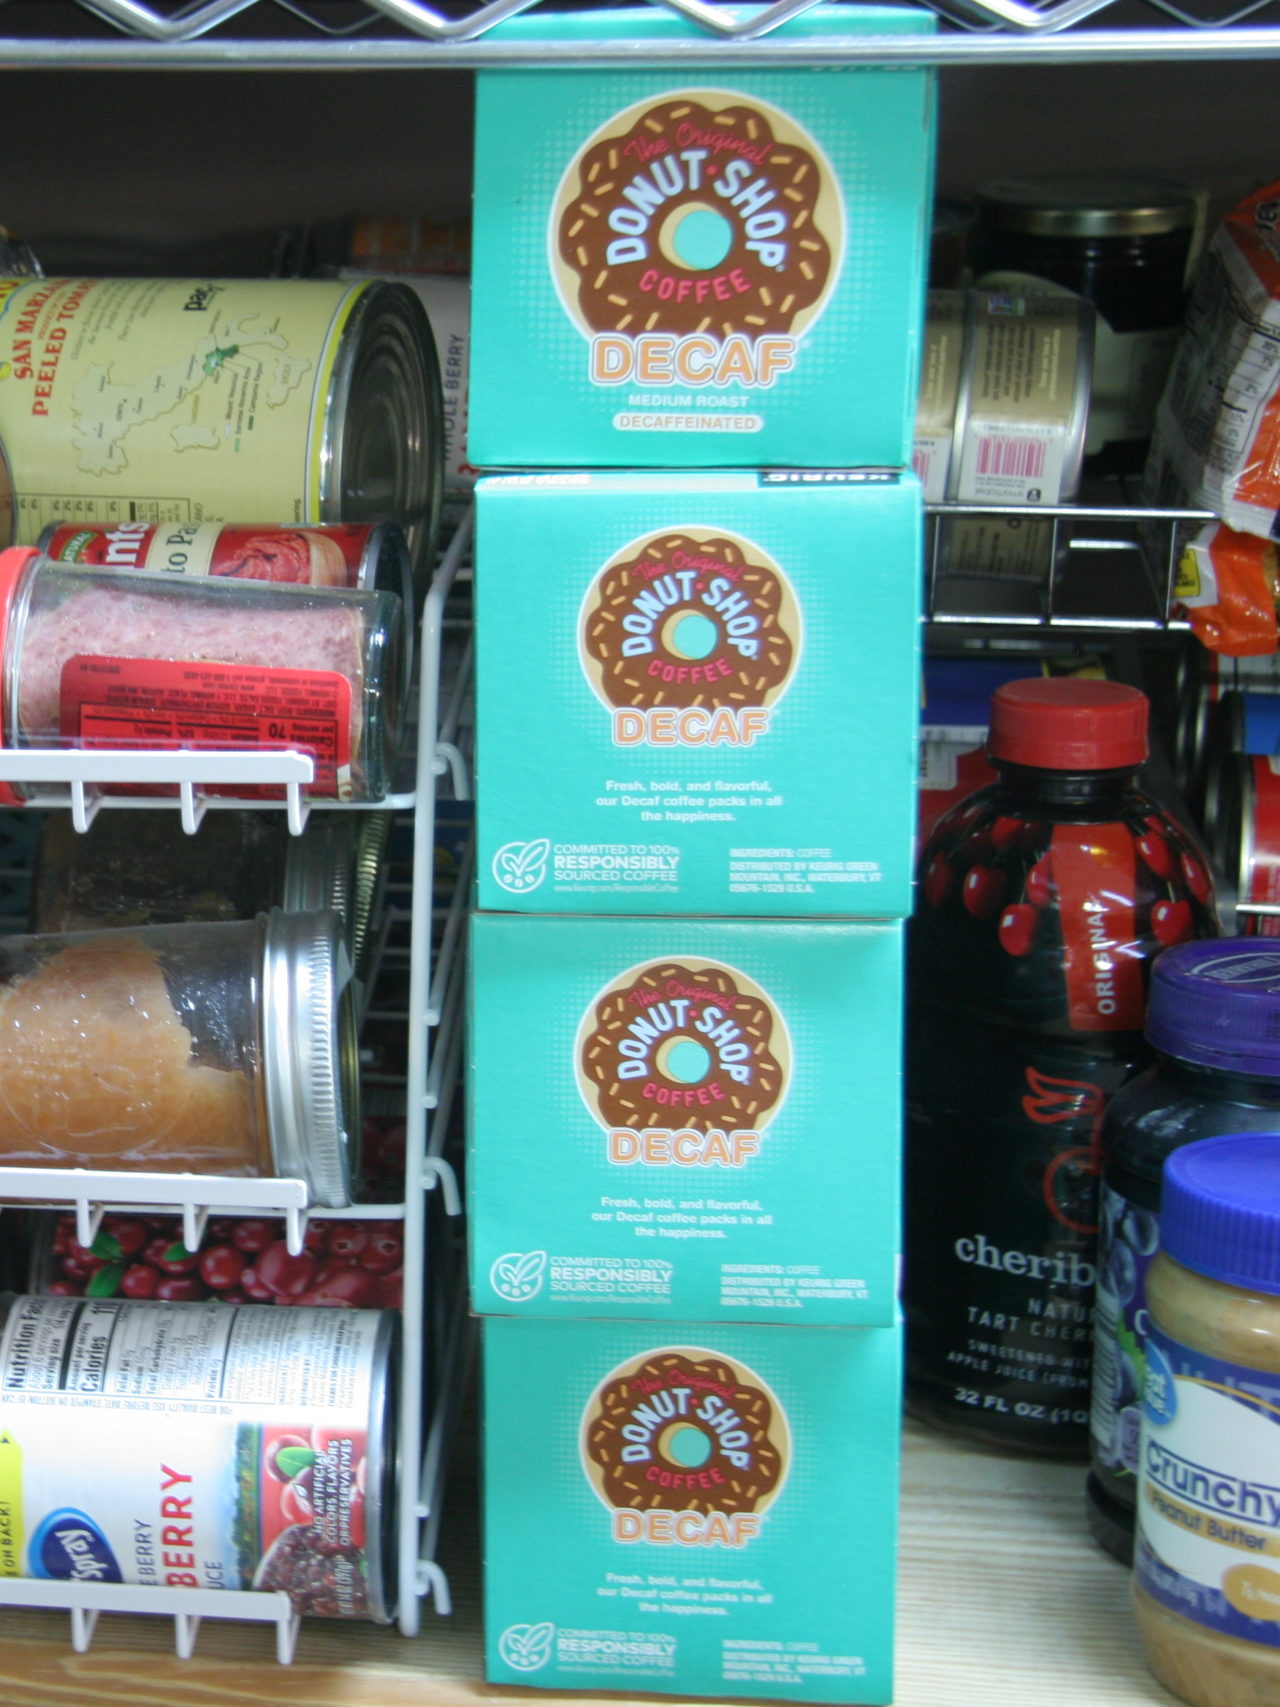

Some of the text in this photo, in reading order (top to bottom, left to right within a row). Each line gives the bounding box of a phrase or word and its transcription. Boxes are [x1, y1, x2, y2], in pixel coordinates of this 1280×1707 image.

[623, 122, 773, 166] The Original
[606, 150, 787, 268] DONUT SHOP
[639, 267, 752, 304] COFFEE
[31, 327, 68, 417] PEELED
[445, 334, 465, 391] BERRY
[593, 337, 795, 384] DECAF
[628, 395, 750, 408] MEDIUM ROAST
[620, 415, 757, 430] DECAFFEINATED
[632, 550, 748, 582] The Original
[622, 571, 759, 658] DONUT SHOP
[648, 658, 733, 685] COFFEE
[268, 722, 286, 739] 70
[613, 710, 768, 745] DECAF
[605, 780, 772, 793] Fresh, bold, and flavorful,
[596, 795, 782, 808] our Decaf coffee packs in all
[641, 811, 736, 823] the happiness.
[553, 855, 680, 870] RESPONSIBLY
[554, 844, 680, 855] COMMITTED TO 100%
[729, 848, 832, 858] INGREDIENTS: COFFEE
[554, 870, 678, 882] SOURCED COFFEE
[729, 861, 789, 872] DISTRIBUTED
[1082, 893, 1117, 1015] ORIGINAL
[628, 979, 739, 1011] The Original
[617, 999, 750, 1084] DONUT SHOP
[642, 1082, 726, 1107] COFFEE
[609, 1129, 759, 1165] DECAF
[600, 1196, 642, 1208] Fresh,
[644, 1198, 676, 1209] bold,
[679, 1199, 704, 1209] and
[591, 1211, 772, 1225] our Decaf coffee packs in all
[635, 1226, 728, 1239] the happiness.
[550, 1256, 641, 1269] COMMITTED TO
[954, 1233, 1097, 1288] cherib
[550, 1267, 674, 1284] RESPONSIBLY
[550, 1281, 672, 1294] SOURCED COFFEE
[968, 1306, 1022, 1333] TART
[5, 1324, 37, 1388] Nutrition
[41, 1338, 62, 1389] Serving size
[80, 1336, 107, 1392] Calories
[968, 1338, 1056, 1366] SWEETENED
[68, 1360, 80, 1390] Amount
[132, 1366, 142, 1394] Sodium
[947, 1350, 991, 1372] APPLE
[994, 1363, 1038, 1383] JUICE
[116, 1374, 127, 1392] Total
[147, 1375, 156, 1394] Total
[206, 1369, 217, 1397] Protein
[954, 1386, 1046, 1420] 32 FL OZ
[621, 1388, 750, 1470] DONUT SHOP
[326, 1440, 338, 1542] COLORS, FLAVORS
[339, 1438, 352, 1546] OR PRESERVATIVES
[645, 1466, 726, 1490] COFFEE
[313, 1452, 325, 1533] NO ARTIFICIAL
[613, 1509, 760, 1547] DECAF
[1152, 1489, 1267, 1551] Peanut Butter
[0, 1550, 14, 1566] ON
[133, 1518, 155, 1575] BERRY
[556, 1638, 677, 1657] RESPONSIBLY
